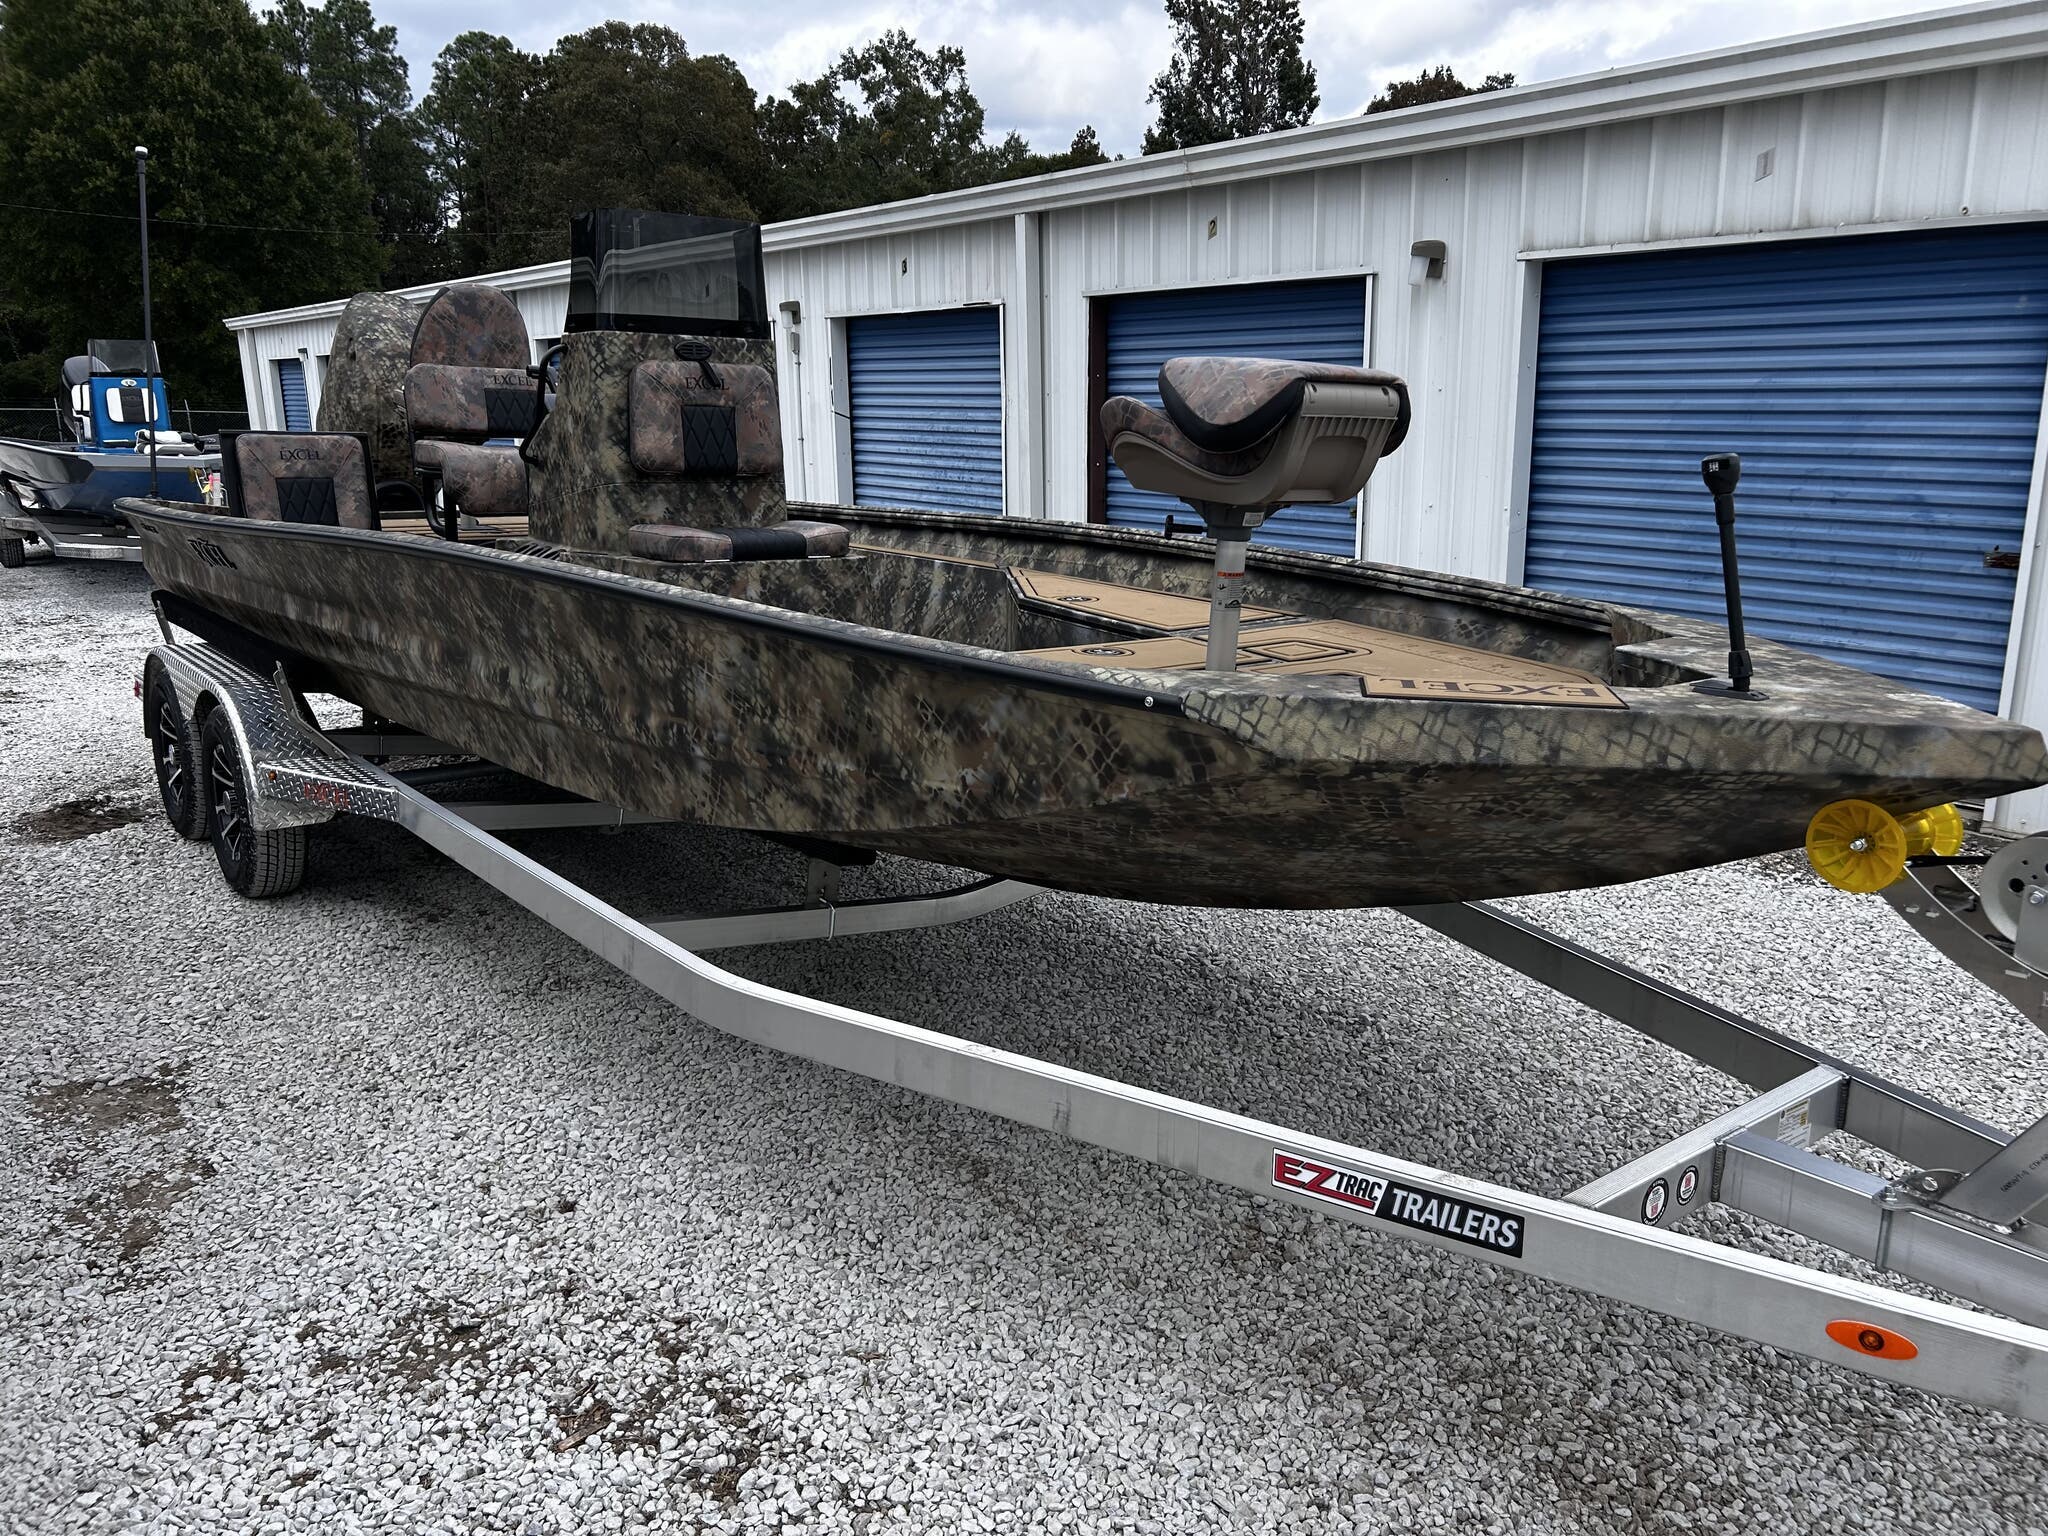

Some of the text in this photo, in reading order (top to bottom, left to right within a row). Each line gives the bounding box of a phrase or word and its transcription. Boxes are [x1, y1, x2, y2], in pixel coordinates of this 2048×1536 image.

[493, 374, 533, 387] EXCEL
[685, 376, 730, 391] EXCL
[280, 448, 323, 461] EXCEL
[1379, 677, 1601, 698] EXCEL
[1391, 1187, 1520, 1249] TRAILERS
